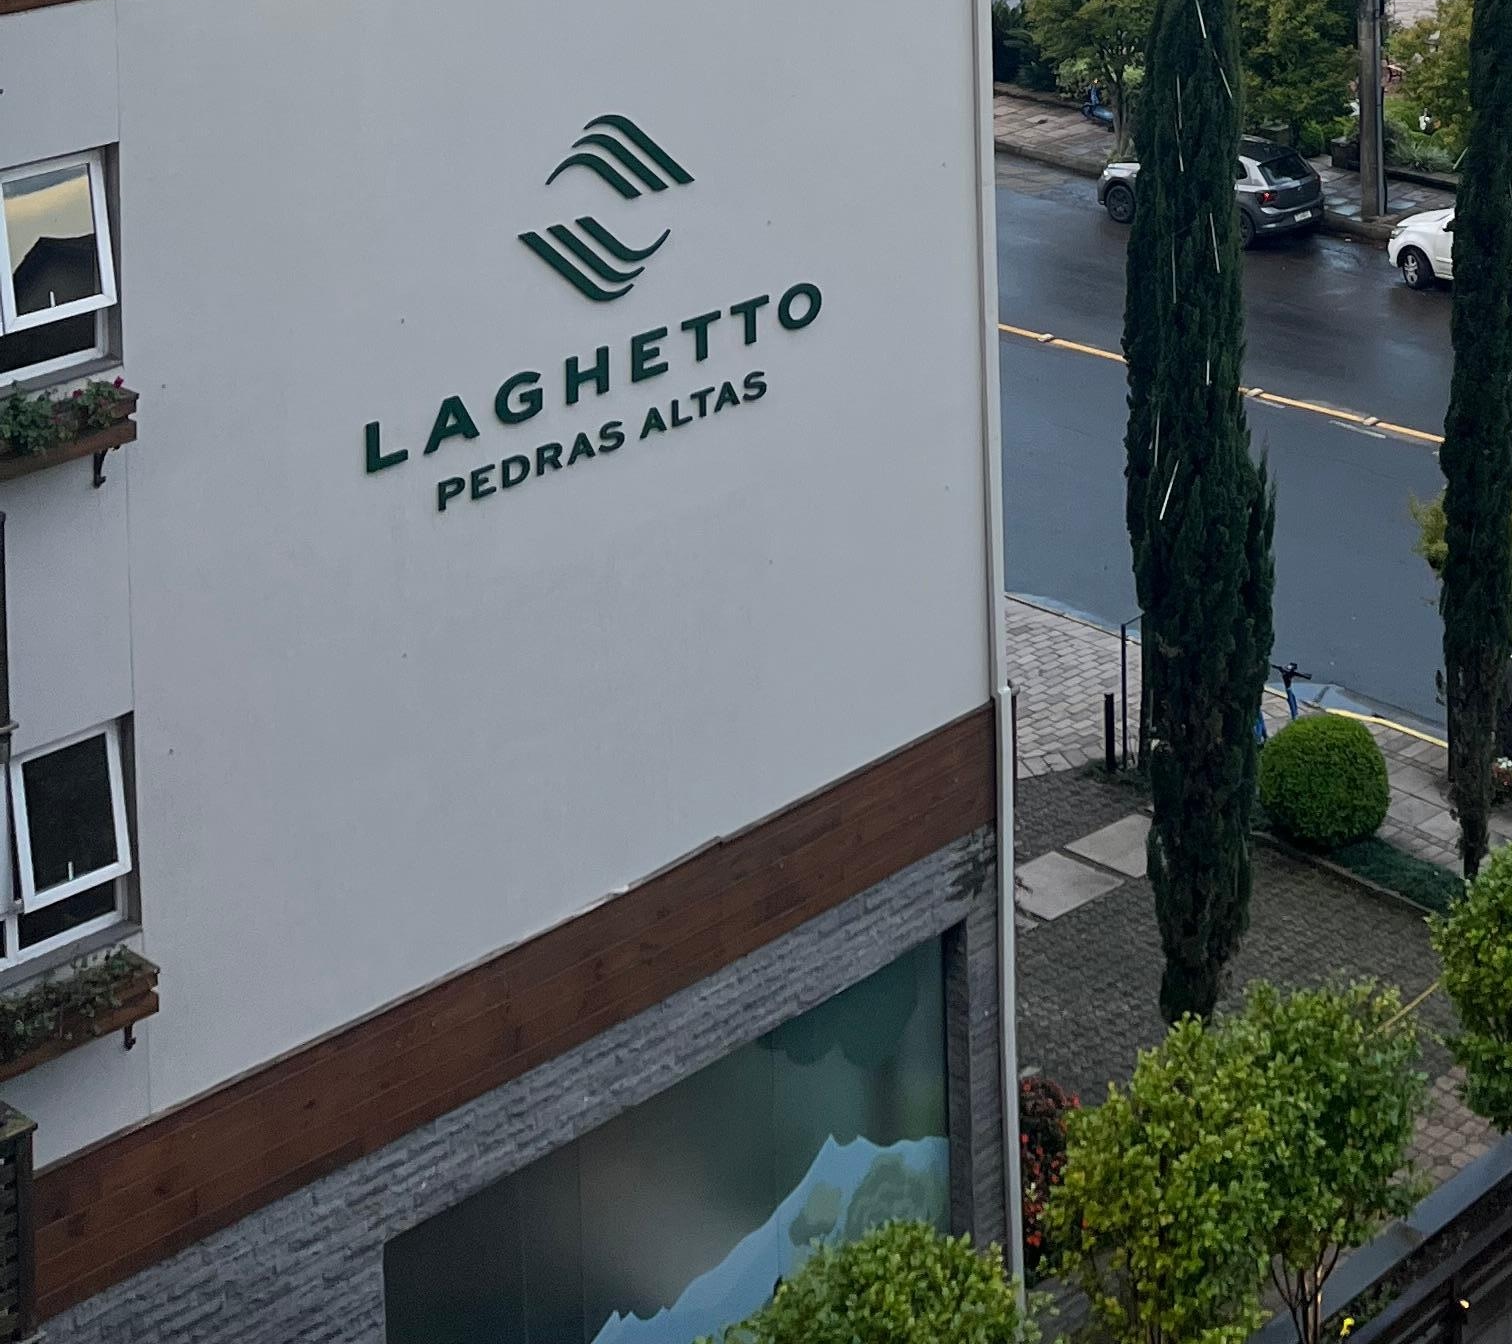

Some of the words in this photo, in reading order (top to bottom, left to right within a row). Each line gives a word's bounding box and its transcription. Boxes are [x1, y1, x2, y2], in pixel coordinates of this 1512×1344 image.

[364, 282, 822, 474] LAGHETTO
[437, 420, 625, 512] PEDRAS
[639, 371, 768, 440] ALTAS
